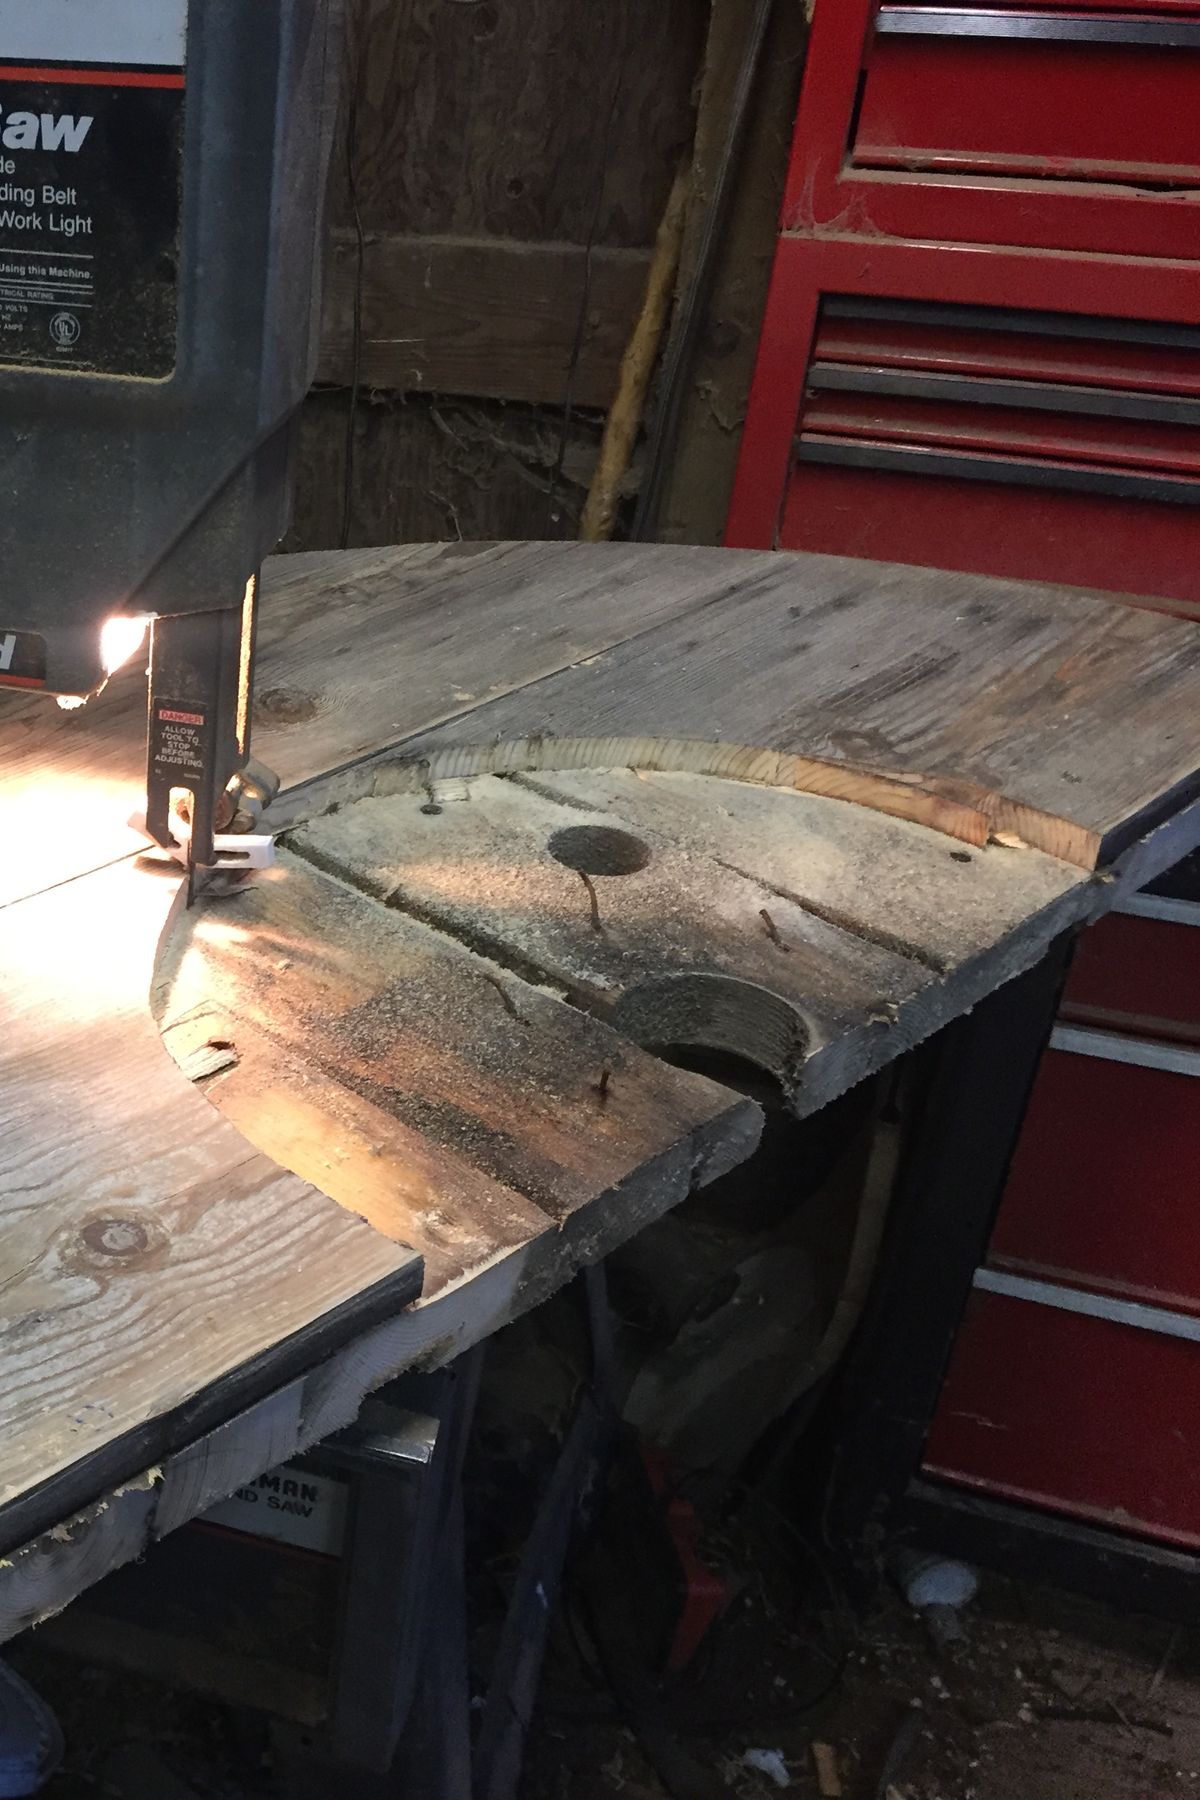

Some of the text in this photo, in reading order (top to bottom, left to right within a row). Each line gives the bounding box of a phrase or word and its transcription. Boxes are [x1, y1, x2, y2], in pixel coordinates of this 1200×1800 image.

[42, 185, 77, 205] Belt
[49, 213, 93, 237] Light
[28, 266, 46, 276] this
[48, 268, 92, 280] Machine.
[161, 710, 202, 724] DANGER
[161, 732, 184, 742] TOOL
[164, 725, 196, 736] ALLOW
[161, 747, 195, 758] BEFORE
[167, 741, 191, 750] STOP
[267, 1496, 314, 1518] SAW
